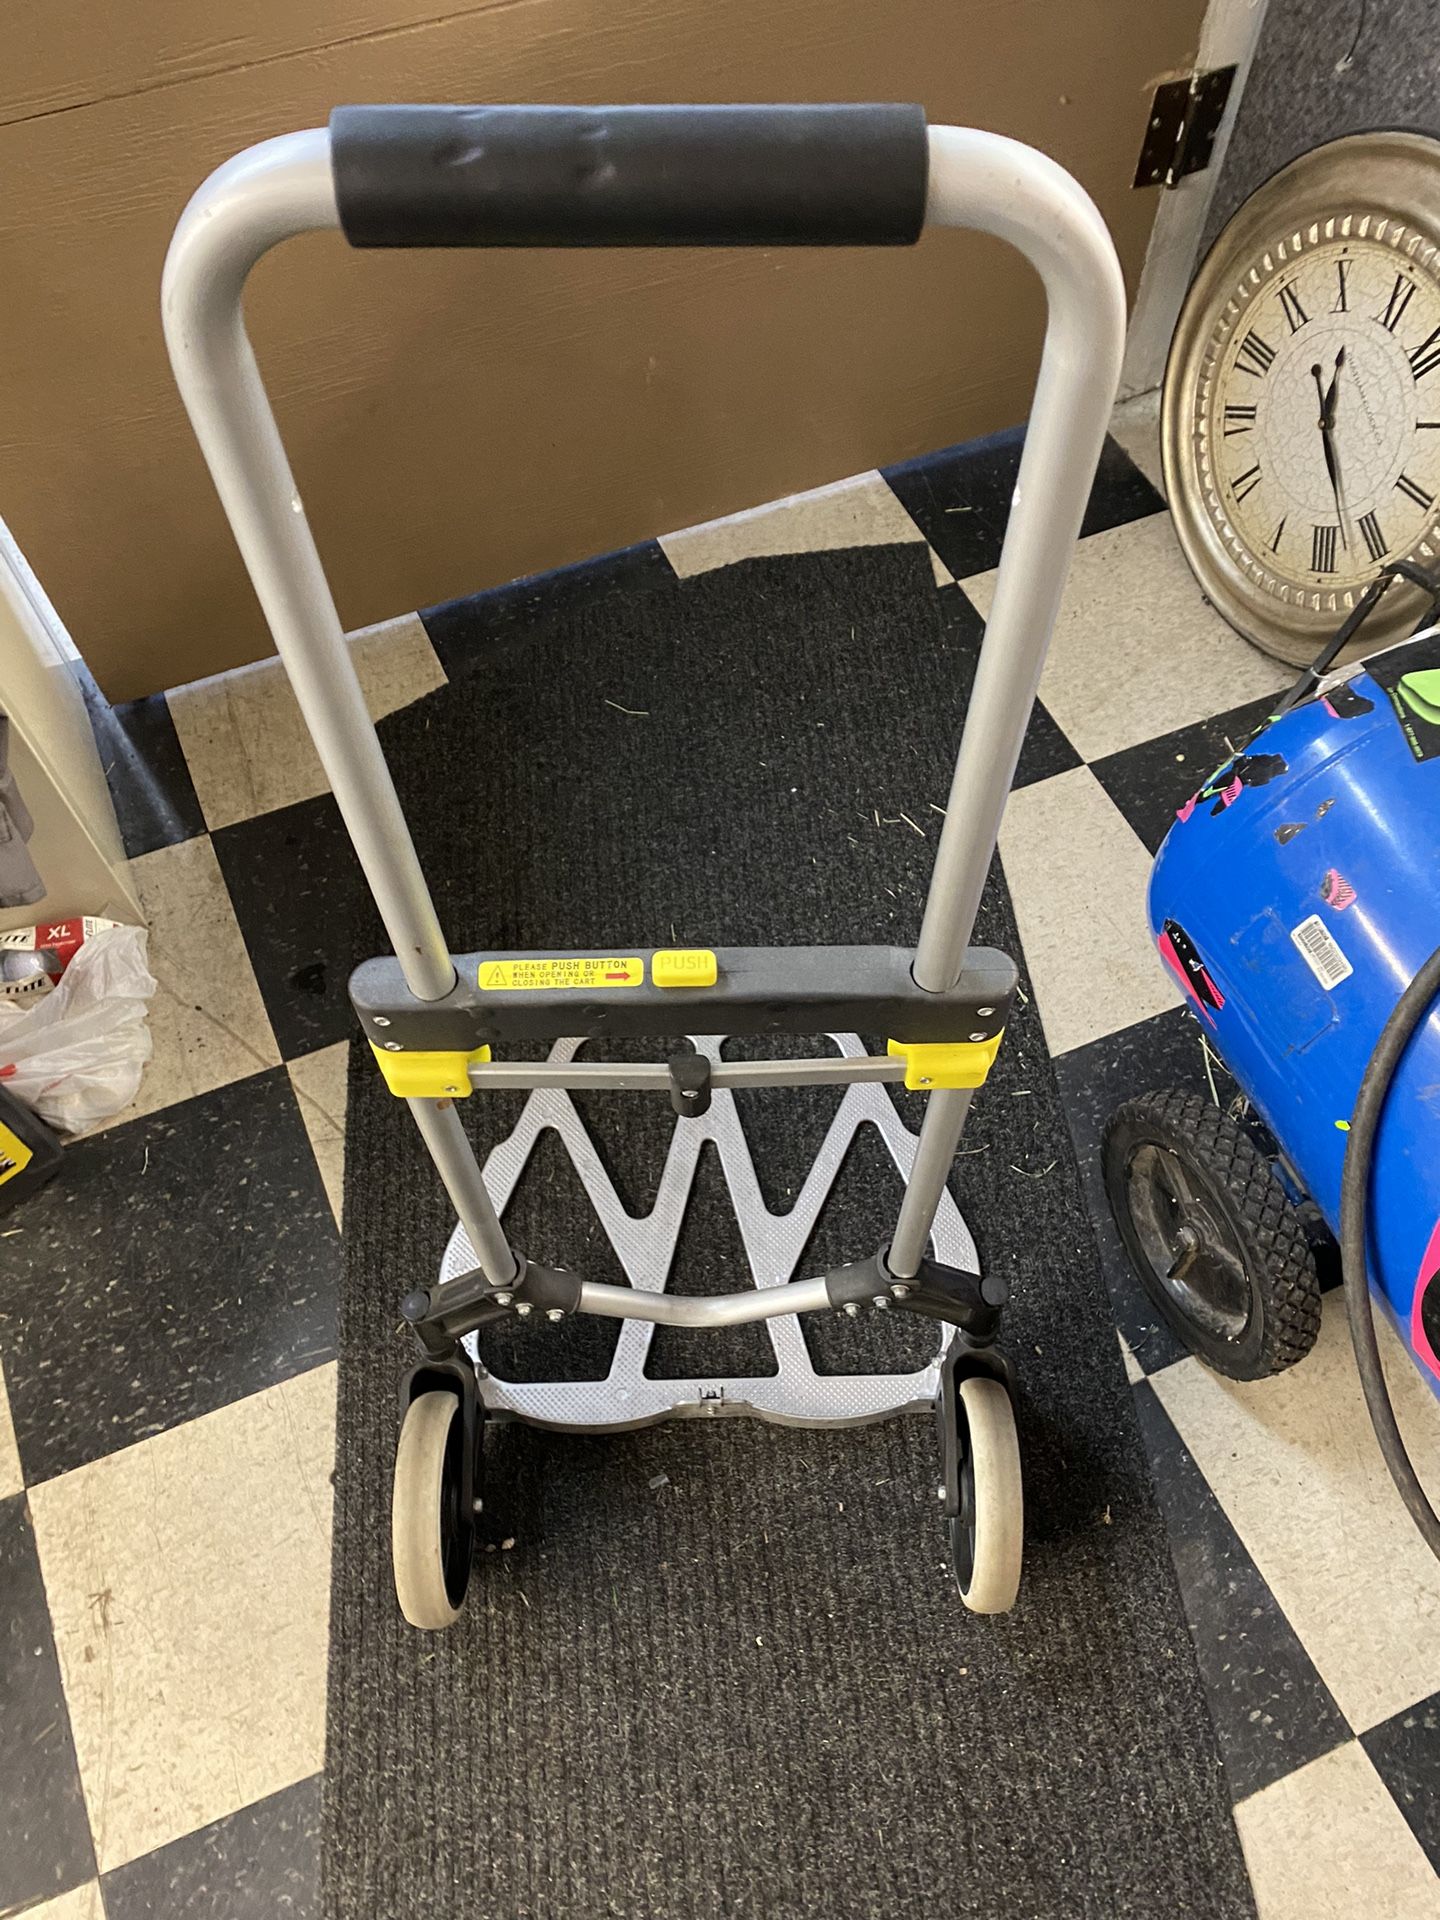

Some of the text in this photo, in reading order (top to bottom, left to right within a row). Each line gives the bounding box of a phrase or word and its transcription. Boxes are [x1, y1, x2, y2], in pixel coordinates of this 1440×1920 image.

[1329, 259, 1354, 314] X
[1233, 327, 1280, 379] VIII
[1224, 402, 1258, 440] VII
[47, 925, 71, 940] XL
[513, 961, 627, 971] PLEASE PUSH BUTTON
[661, 956, 708, 969] PUSH
[512, 971, 536, 979] WHEN
[539, 970, 579, 978] OPENING
[512, 979, 550, 987] CLOSING
